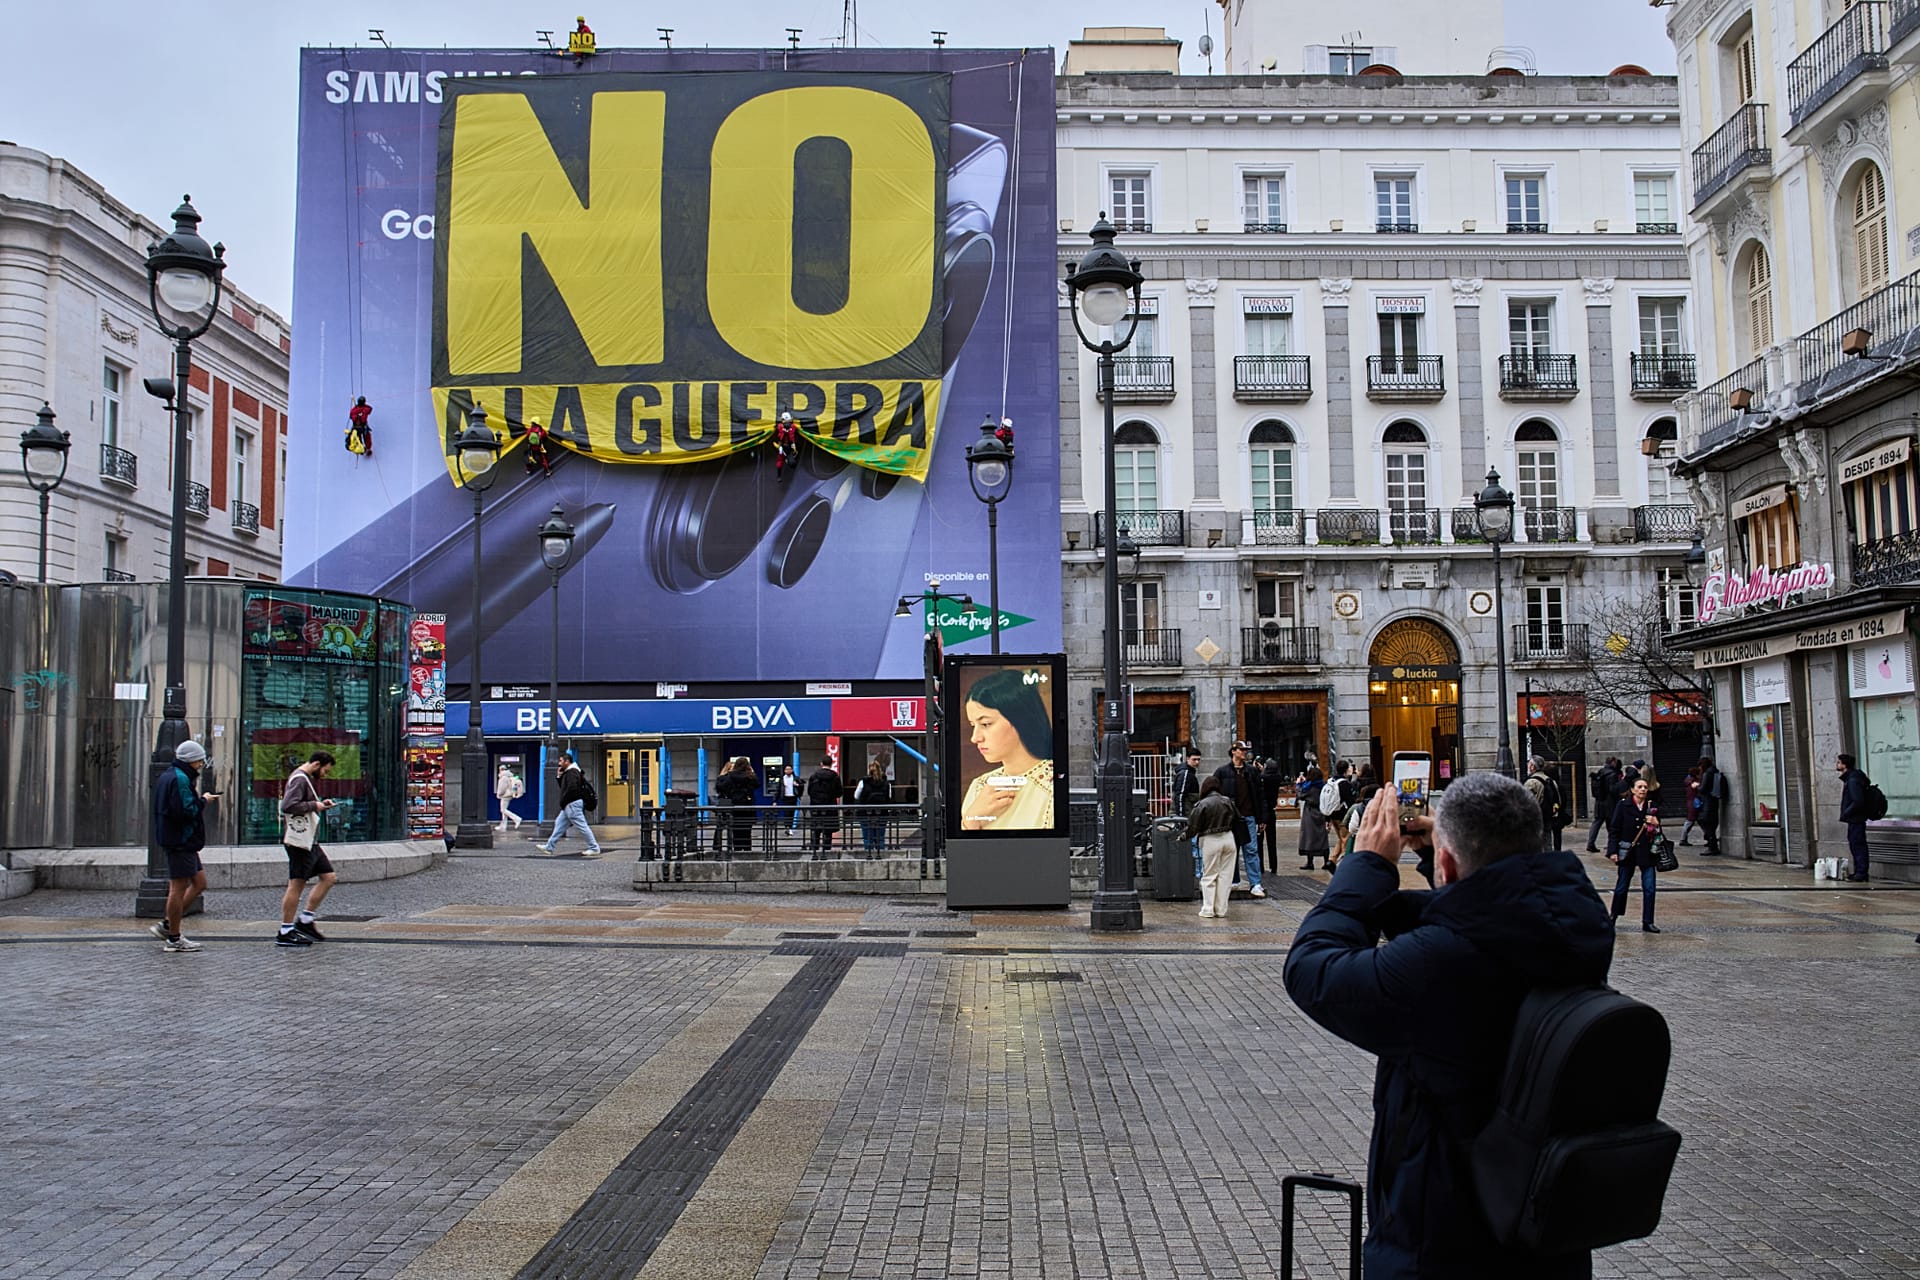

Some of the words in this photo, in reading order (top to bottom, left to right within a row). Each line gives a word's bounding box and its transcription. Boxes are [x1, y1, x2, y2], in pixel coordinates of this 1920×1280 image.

[570, 33, 594, 45] NO
[326, 70, 537, 104] SAMS
[447, 86, 936, 375] NO
[1249, 298, 1289, 306] HOSTAL
[614, 381, 927, 456] GUERRA
[1844, 457, 1875, 479] DESDE
[1879, 447, 1902, 466] 1894
[1745, 495, 1771, 513] SALÓN
[924, 572, 974, 582] Disponible
[976, 573, 989, 581] en
[1697, 575, 1721, 621] La
[1723, 562, 1829, 609] Mallorquina
[311, 605, 360, 622] MADRID
[1703, 651, 1713, 665] LA
[1715, 642, 1769, 663] MALLORQUINA
[1795, 630, 1837, 648] Fundada
[1841, 628, 1854, 643] en
[1858, 618, 1885, 639] 1894
[1406, 668, 1438, 677] luckia
[712, 702, 795, 730] BBVA
[1402, 779, 1418, 793] NO
